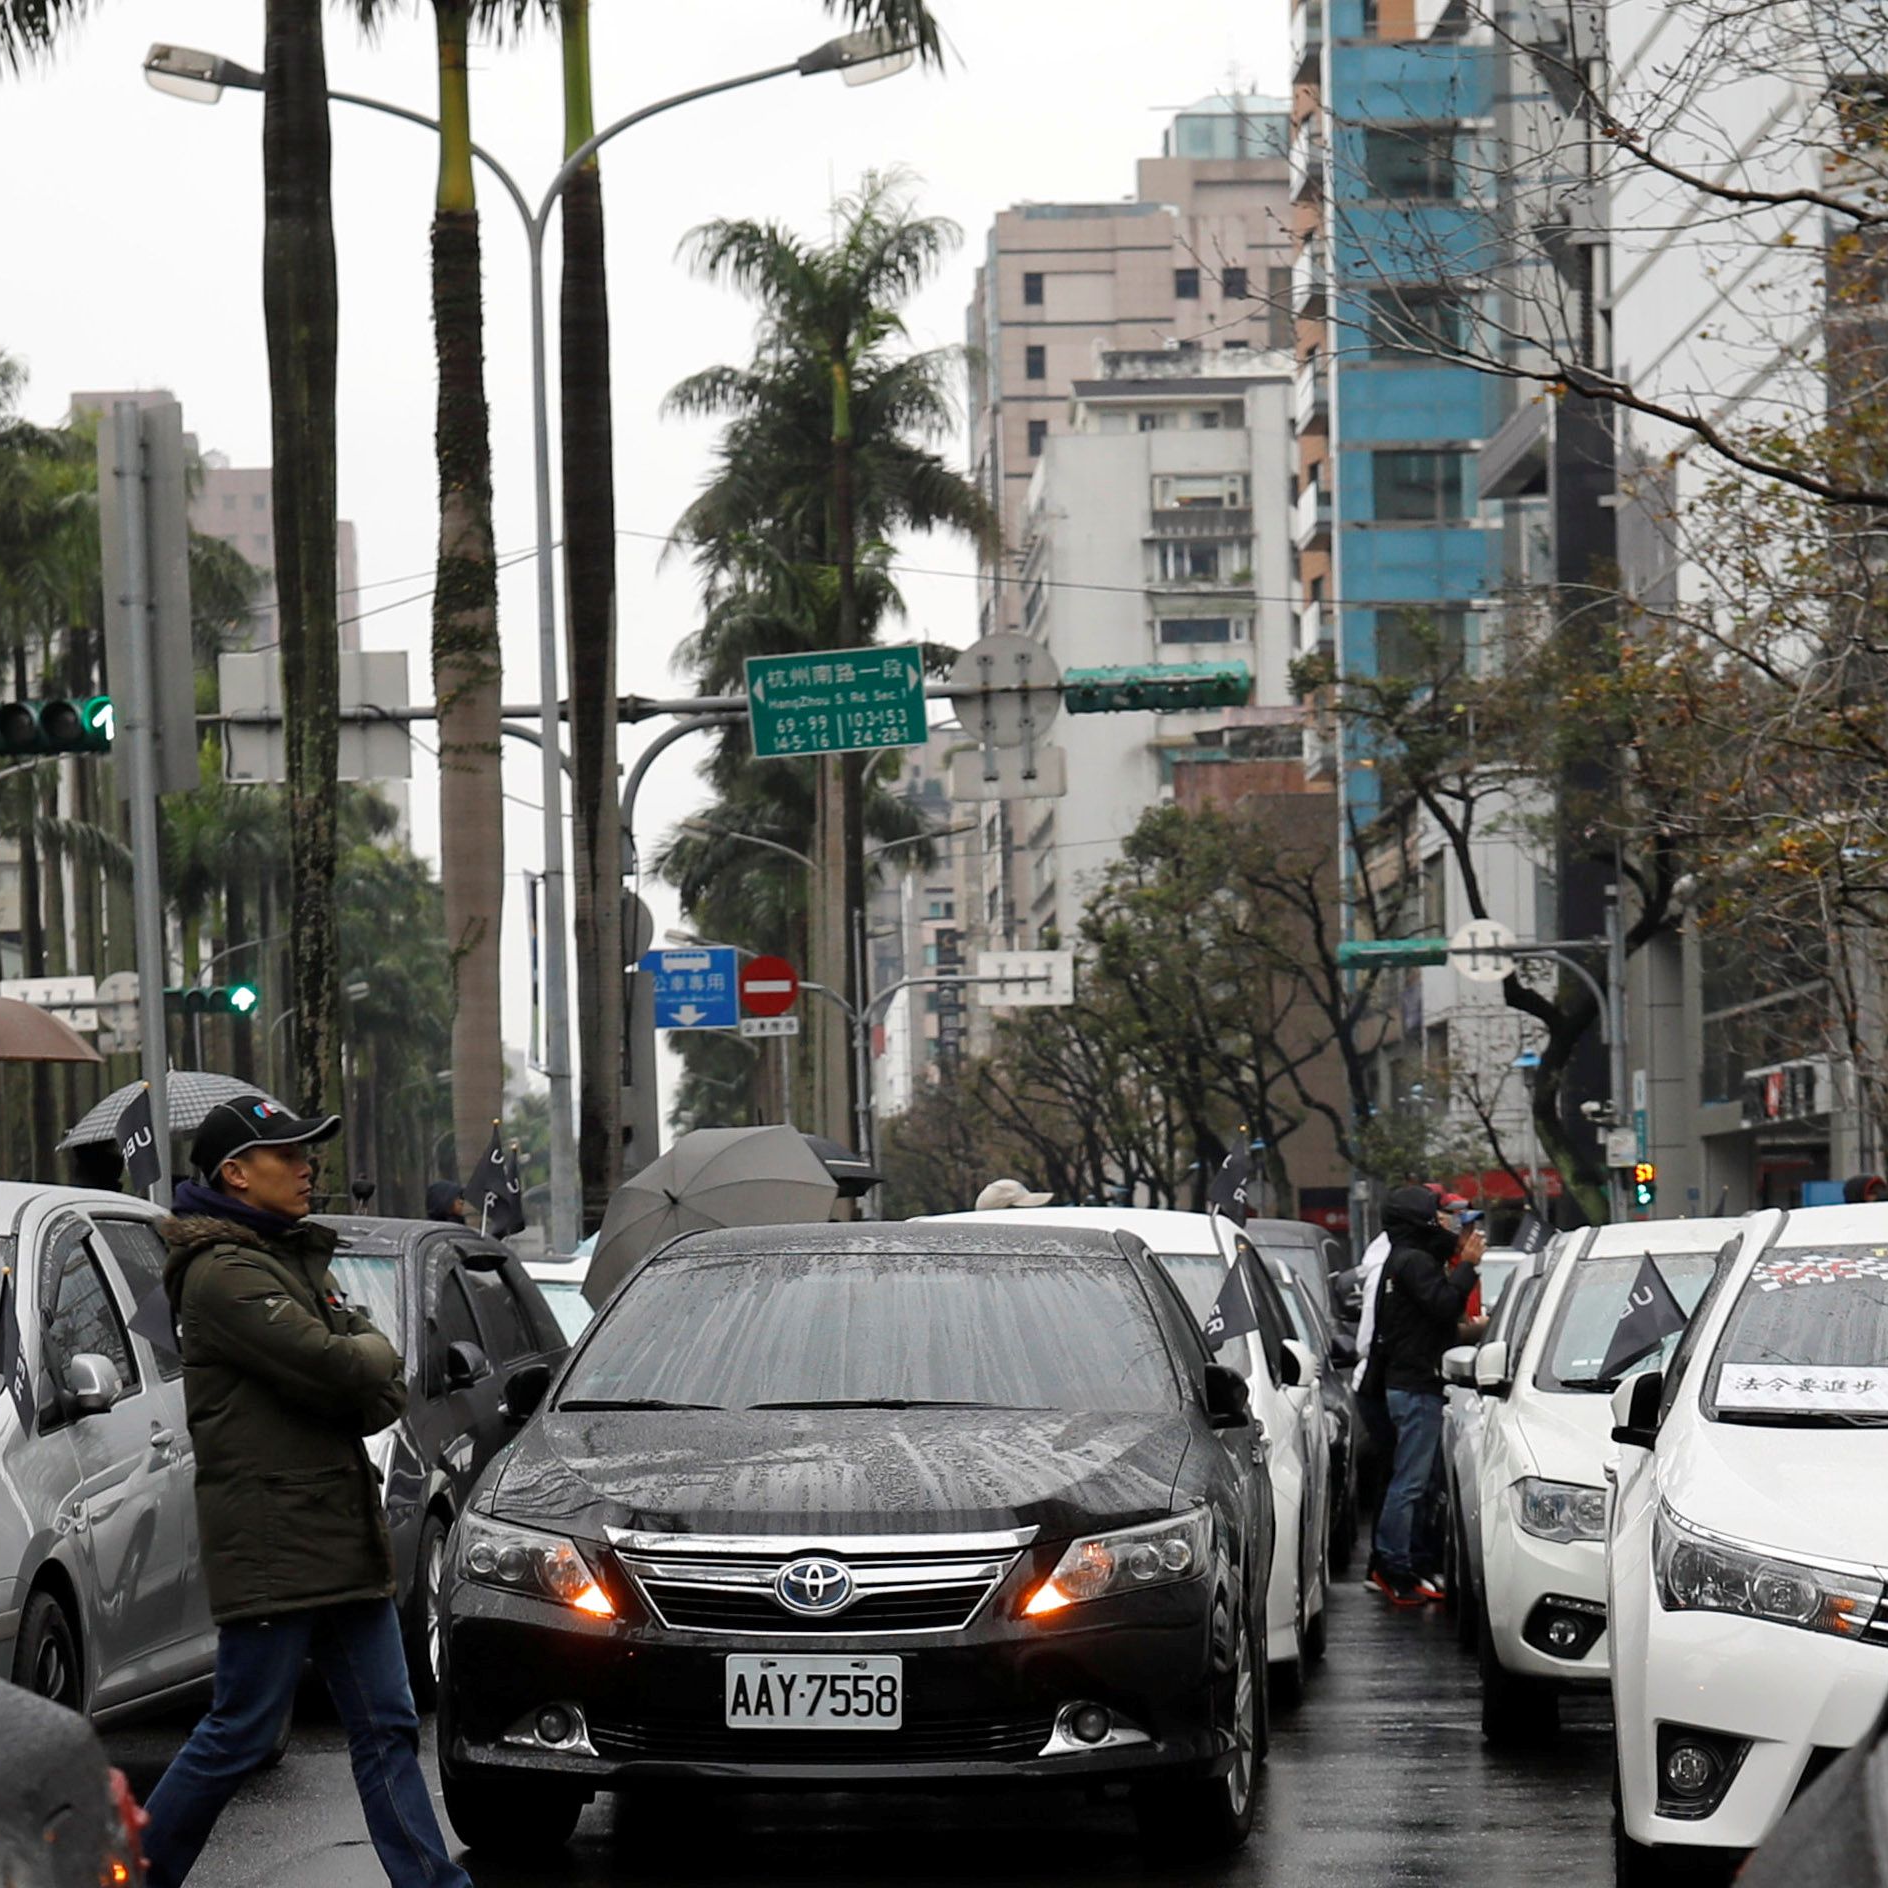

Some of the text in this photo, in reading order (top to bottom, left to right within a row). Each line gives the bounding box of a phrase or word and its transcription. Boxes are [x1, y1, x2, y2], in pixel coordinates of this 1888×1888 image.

[767, 658, 904, 689] 杭州南路一段
[653, 973, 726, 992] 公車專用
[1734, 1376, 1878, 1395] 法令要進步
